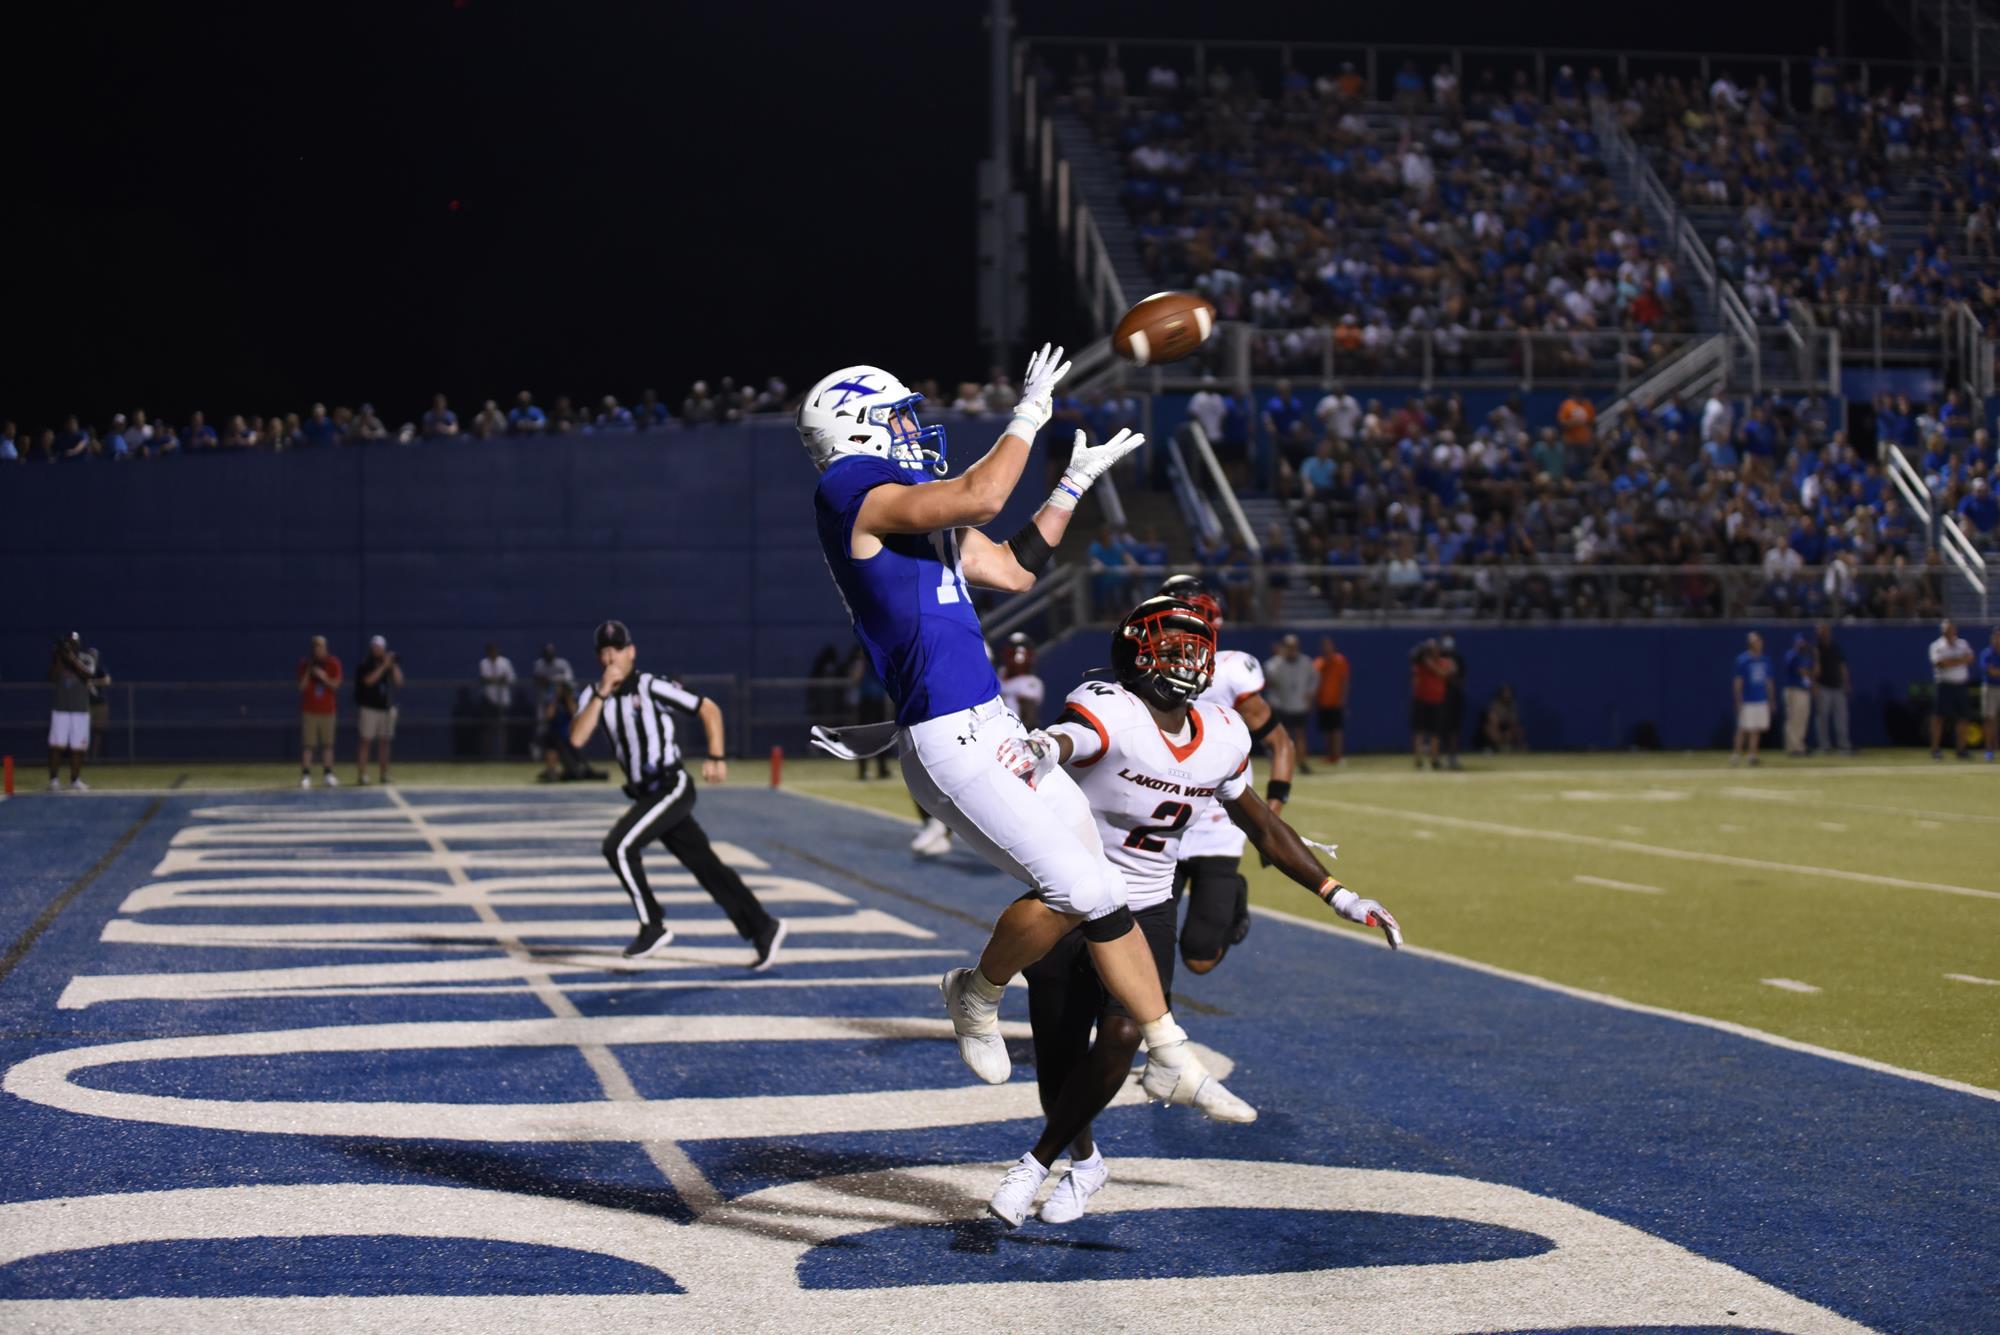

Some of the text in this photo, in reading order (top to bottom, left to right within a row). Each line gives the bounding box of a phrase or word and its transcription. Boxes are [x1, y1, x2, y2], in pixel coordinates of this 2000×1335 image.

[1117, 768, 1181, 795] LAKOTA
[1183, 786, 1217, 798] WES
[1122, 800, 1193, 853] 2
